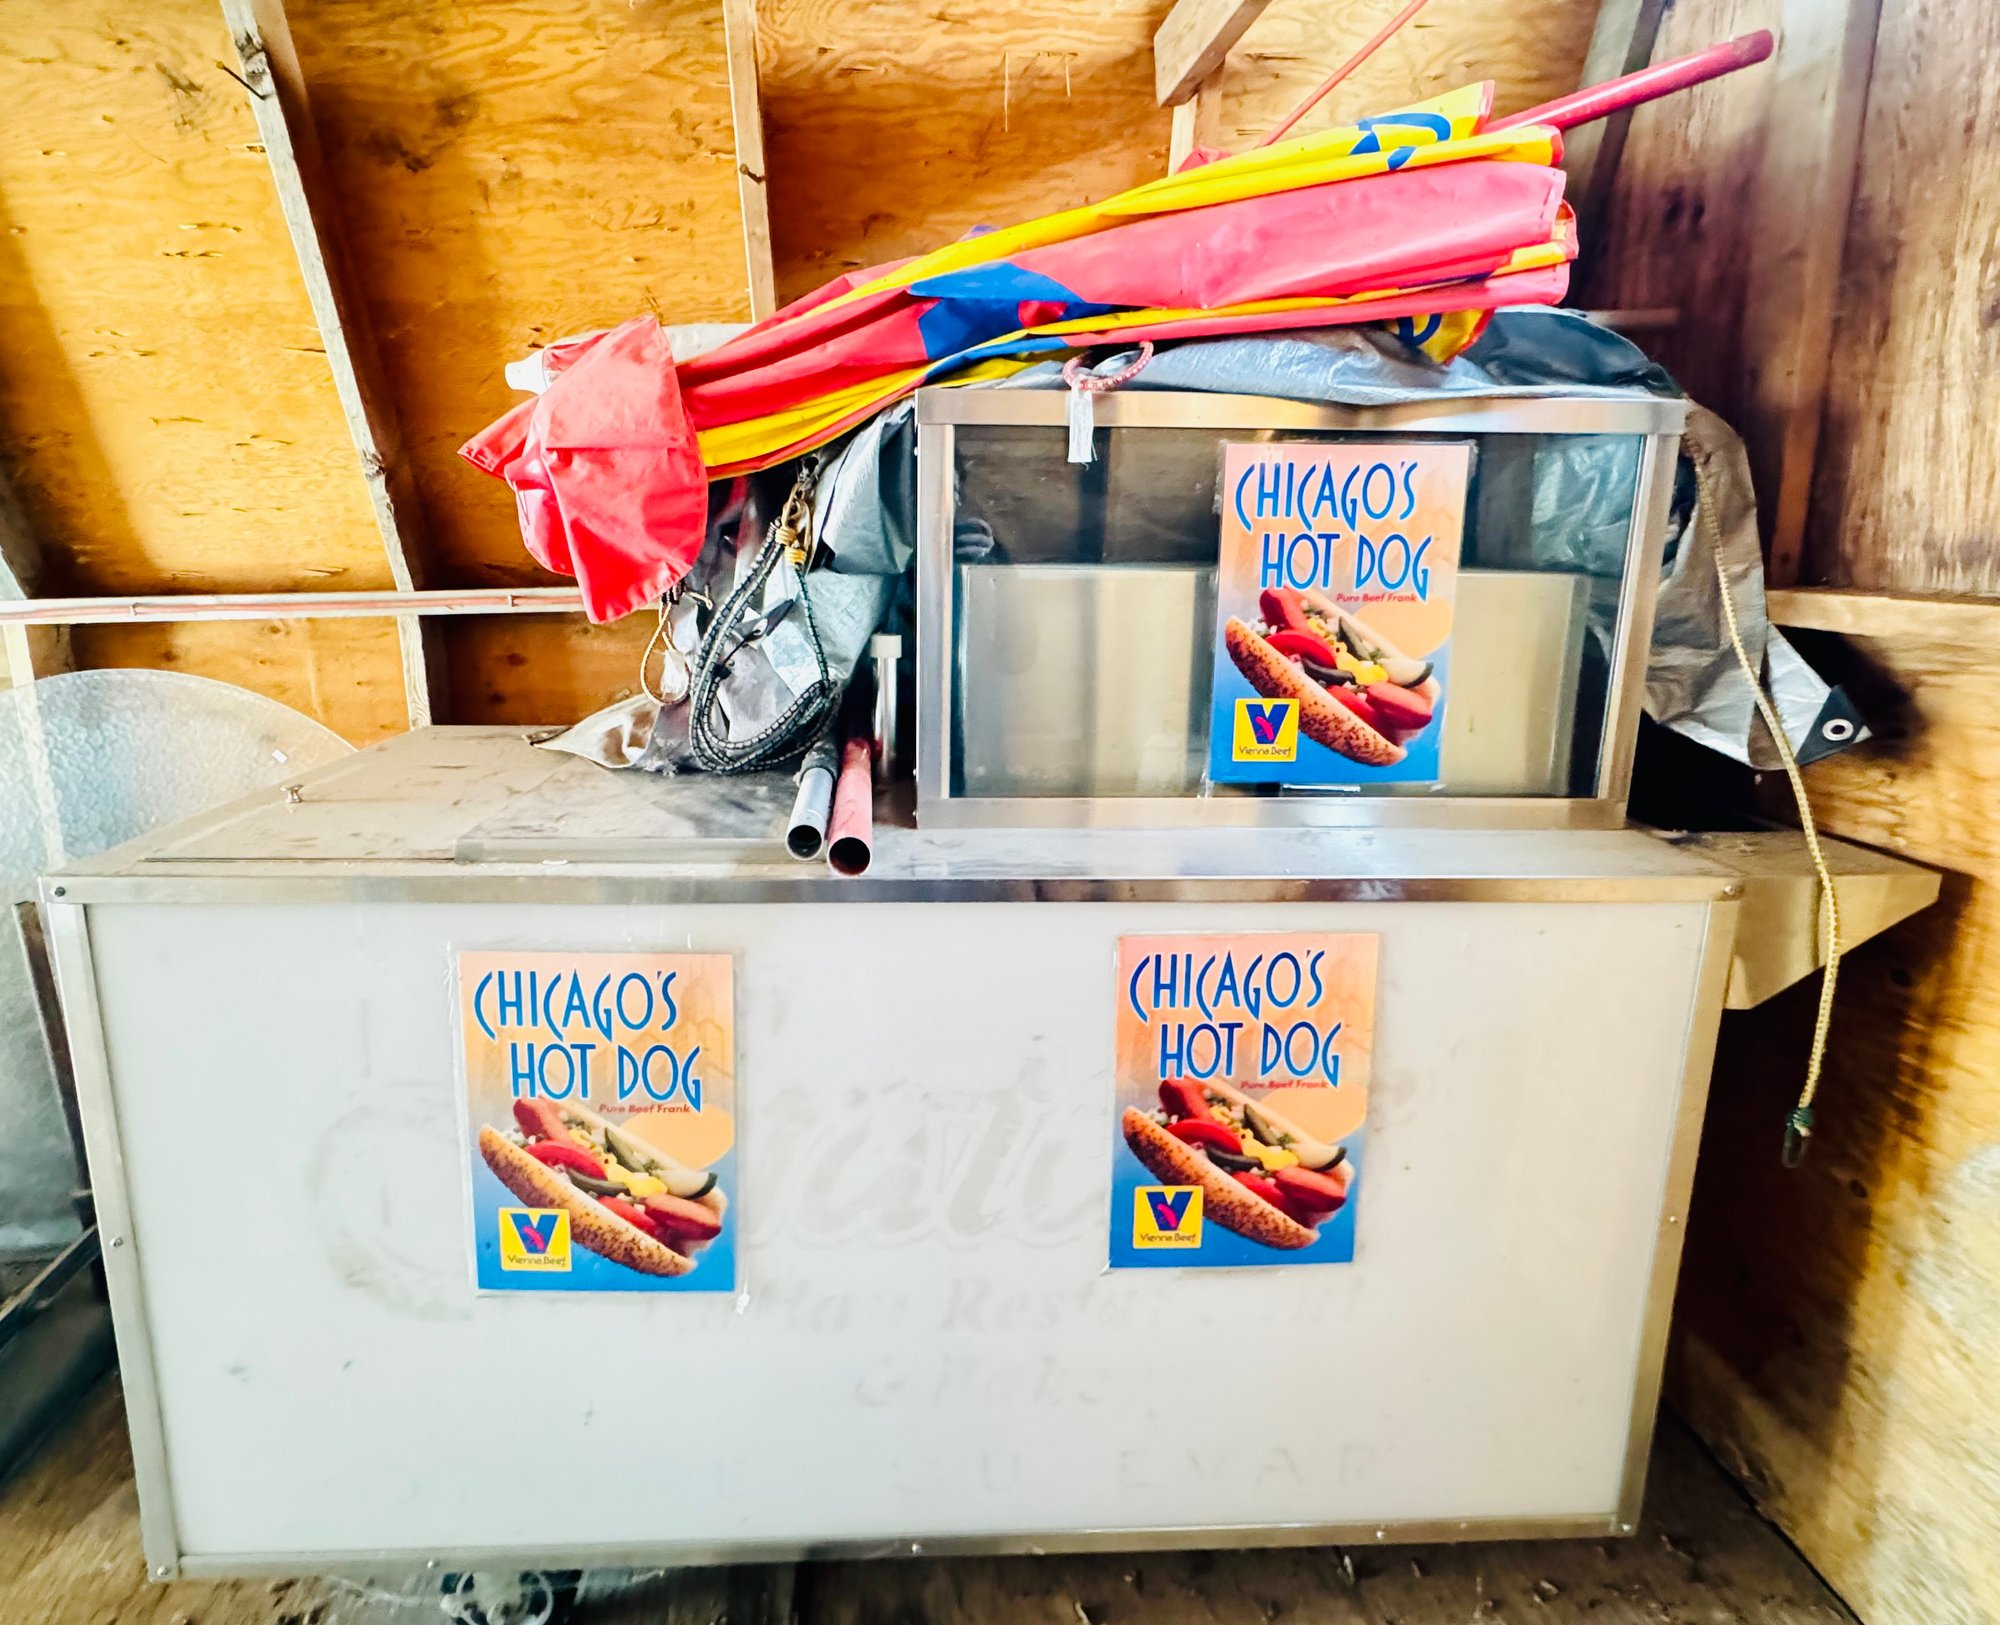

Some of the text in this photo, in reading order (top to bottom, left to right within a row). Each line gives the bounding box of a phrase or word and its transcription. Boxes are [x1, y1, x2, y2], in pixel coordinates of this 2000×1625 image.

[1236, 460, 1418, 532] CHICAGO'S
[1261, 533, 1432, 601] HOT DOG
[1336, 592, 1417, 602] Pure Beef Frank
[1239, 746, 1291, 757] Vienna Beef
[474, 969, 677, 1042] CHICAGO'S
[1129, 949, 1325, 1023] CHICAGO'S
[510, 1043, 701, 1113] HOT DOG
[1160, 1021, 1342, 1089] HOT DOG
[599, 1104, 691, 1114] Pure Beef Frank
[507, 1254, 566, 1267] Vienna Beef
[1140, 1232, 1196, 1243] Vienna Beef
